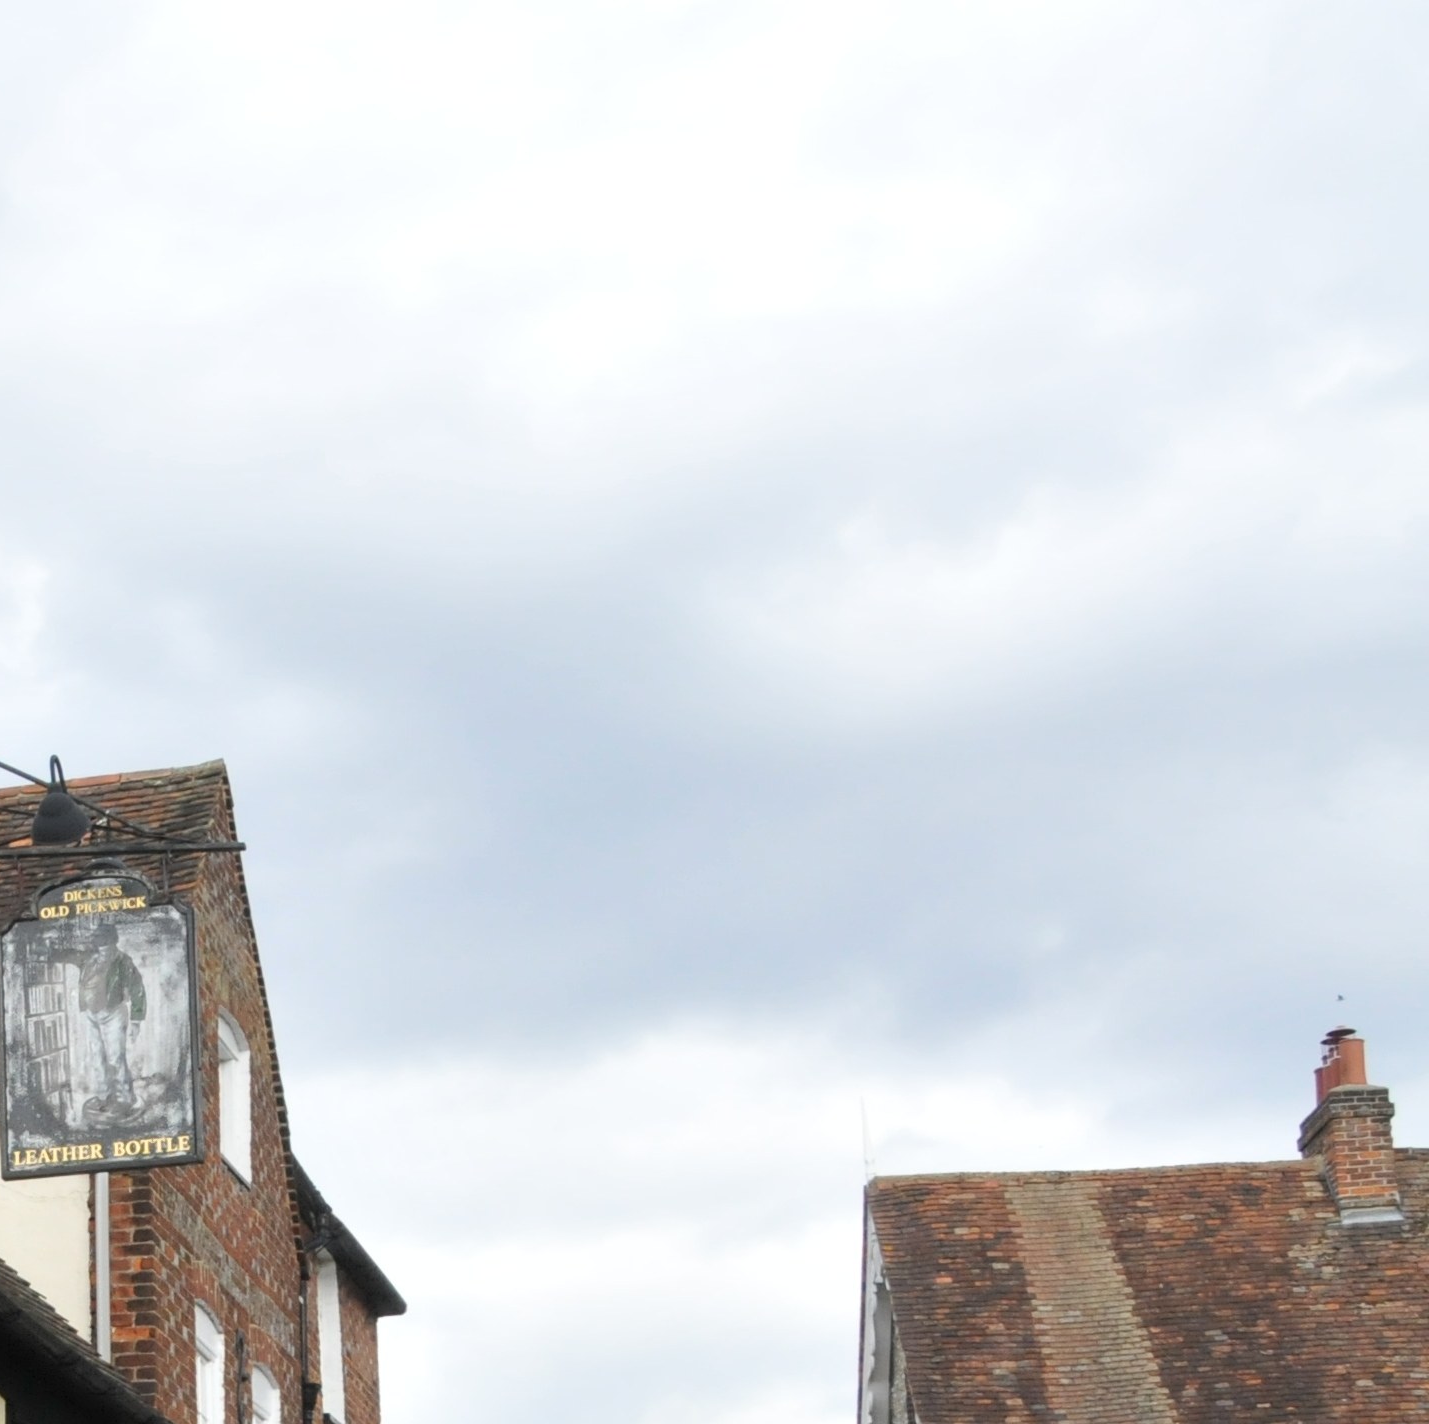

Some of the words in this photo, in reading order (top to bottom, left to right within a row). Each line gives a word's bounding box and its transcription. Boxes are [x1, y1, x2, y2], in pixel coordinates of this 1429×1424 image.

[63, 885, 123, 903] DICKENS
[40, 905, 70, 919] OLD
[76, 896, 146, 915] PICKWICK
[13, 1144, 104, 1166] LEATHER
[113, 1135, 191, 1158] BOTTLE
